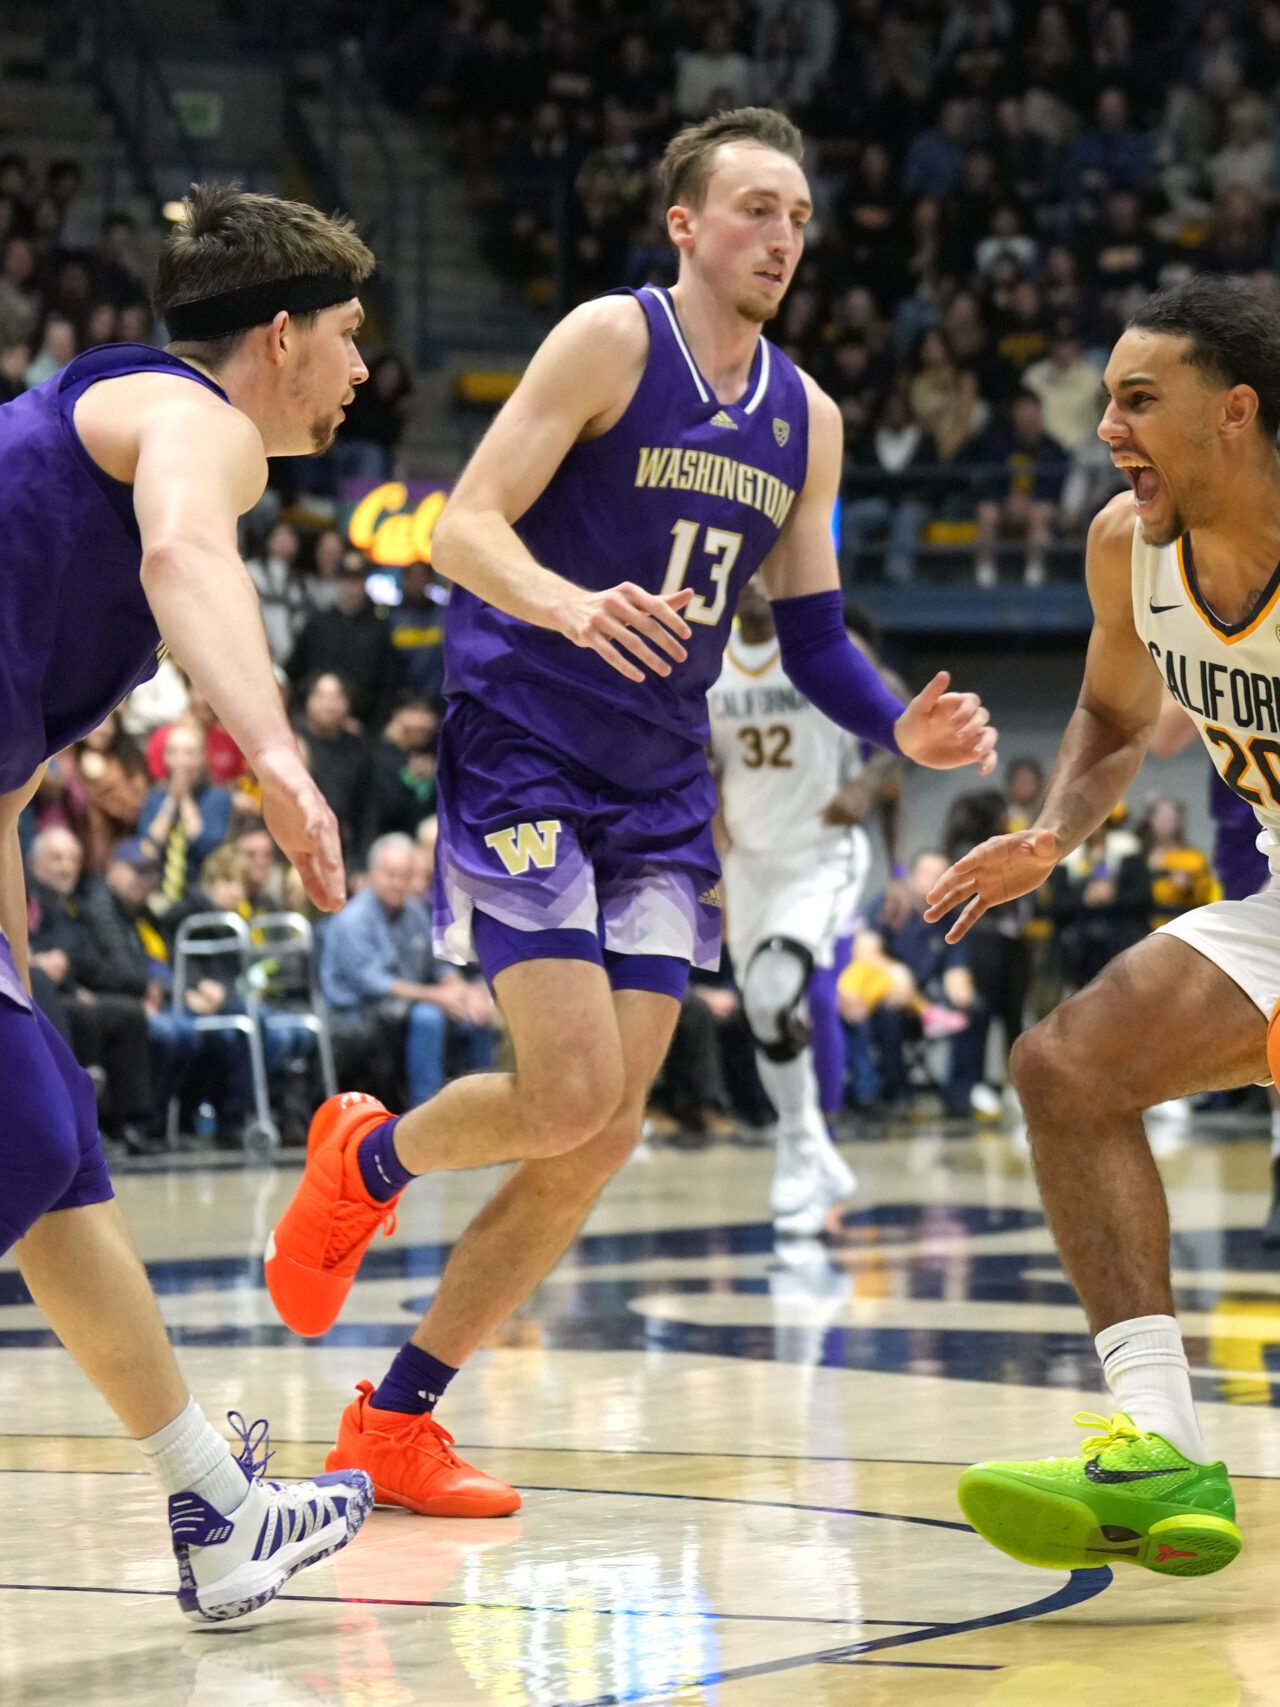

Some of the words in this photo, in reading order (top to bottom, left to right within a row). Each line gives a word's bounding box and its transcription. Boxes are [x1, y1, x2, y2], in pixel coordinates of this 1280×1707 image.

[349, 482, 446, 566] Cal
[634, 447, 796, 529] WASHINGTON
[660, 518, 744, 627] 13
[737, 724, 794, 769] 32
[484, 820, 562, 876] W
